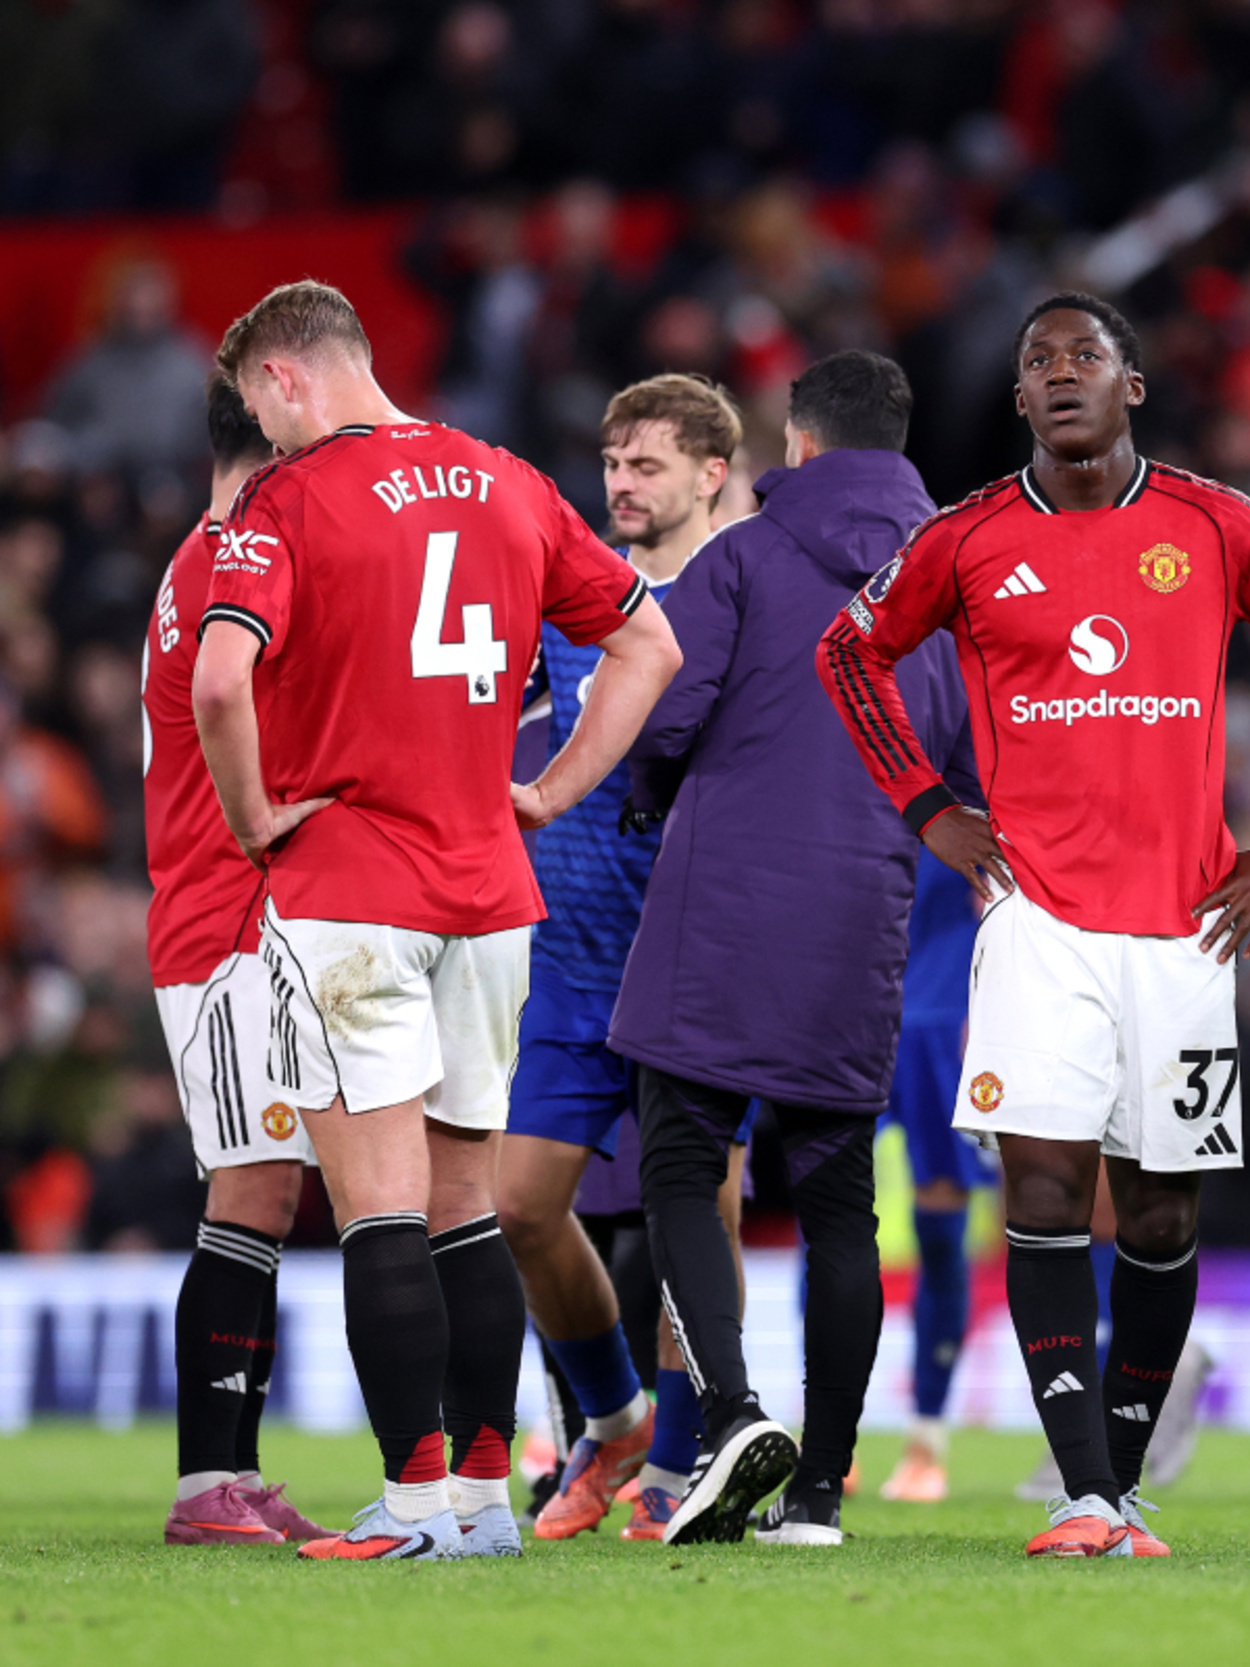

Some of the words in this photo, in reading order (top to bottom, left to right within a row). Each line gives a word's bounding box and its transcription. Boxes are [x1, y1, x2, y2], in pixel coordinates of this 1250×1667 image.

[371, 468, 418, 514] DE
[412, 464, 495, 503] LIGT
[410, 531, 508, 704] 4
[1010, 689, 1201, 726] Snapdragon
[1173, 1048, 1239, 1120] 37
[1027, 1335, 1082, 1355] MUFC
[1121, 1362, 1172, 1382] MUFC
